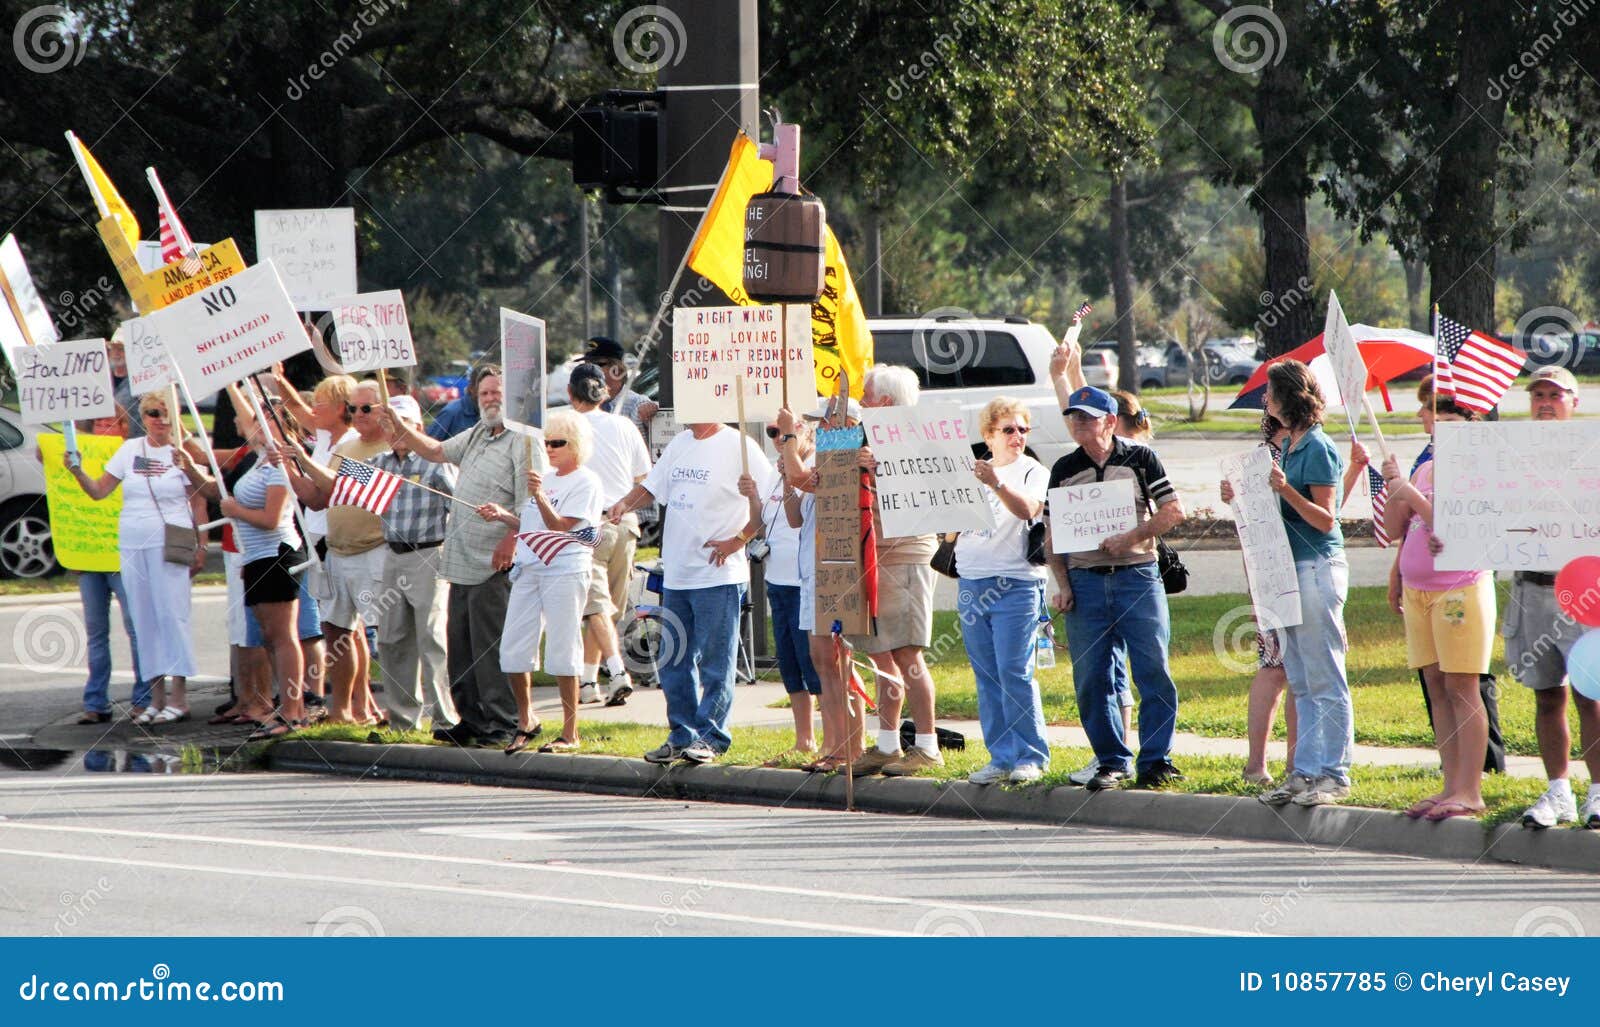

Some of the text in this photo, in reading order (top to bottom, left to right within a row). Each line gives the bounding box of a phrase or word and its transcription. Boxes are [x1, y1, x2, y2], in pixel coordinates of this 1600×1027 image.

[163, 251, 222, 288] AMECA
[162, 288, 182, 305] LAND
[186, 283, 195, 296] OF
[214, 267, 234, 284] FREE
[201, 285, 237, 316] NO
[340, 303, 405, 328] FOR INFO
[697, 309, 773, 325] RIGHT WING
[196, 313, 270, 353] SOCIALIZED
[688, 330, 777, 345] GOD LOVING
[201, 331, 286, 377] HEALTHCARE
[341, 338, 410, 360] 478-4936
[673, 349, 740, 362] EXTREMIST
[62, 351, 105, 377] INFO
[687, 366, 785, 380] AND PROUD
[22, 387, 104, 412] 478-4936
[715, 382, 769, 397] OF IT
[871, 419, 968, 445] CHANGE
[672, 467, 711, 481] CHANGE
[1067, 487, 1103, 505] NO
[1062, 505, 1135, 526] SOCIALIZED
[1441, 500, 1463, 516] NO
[1538, 522, 1562, 538] NO
[1486, 542, 1553, 565] USA
